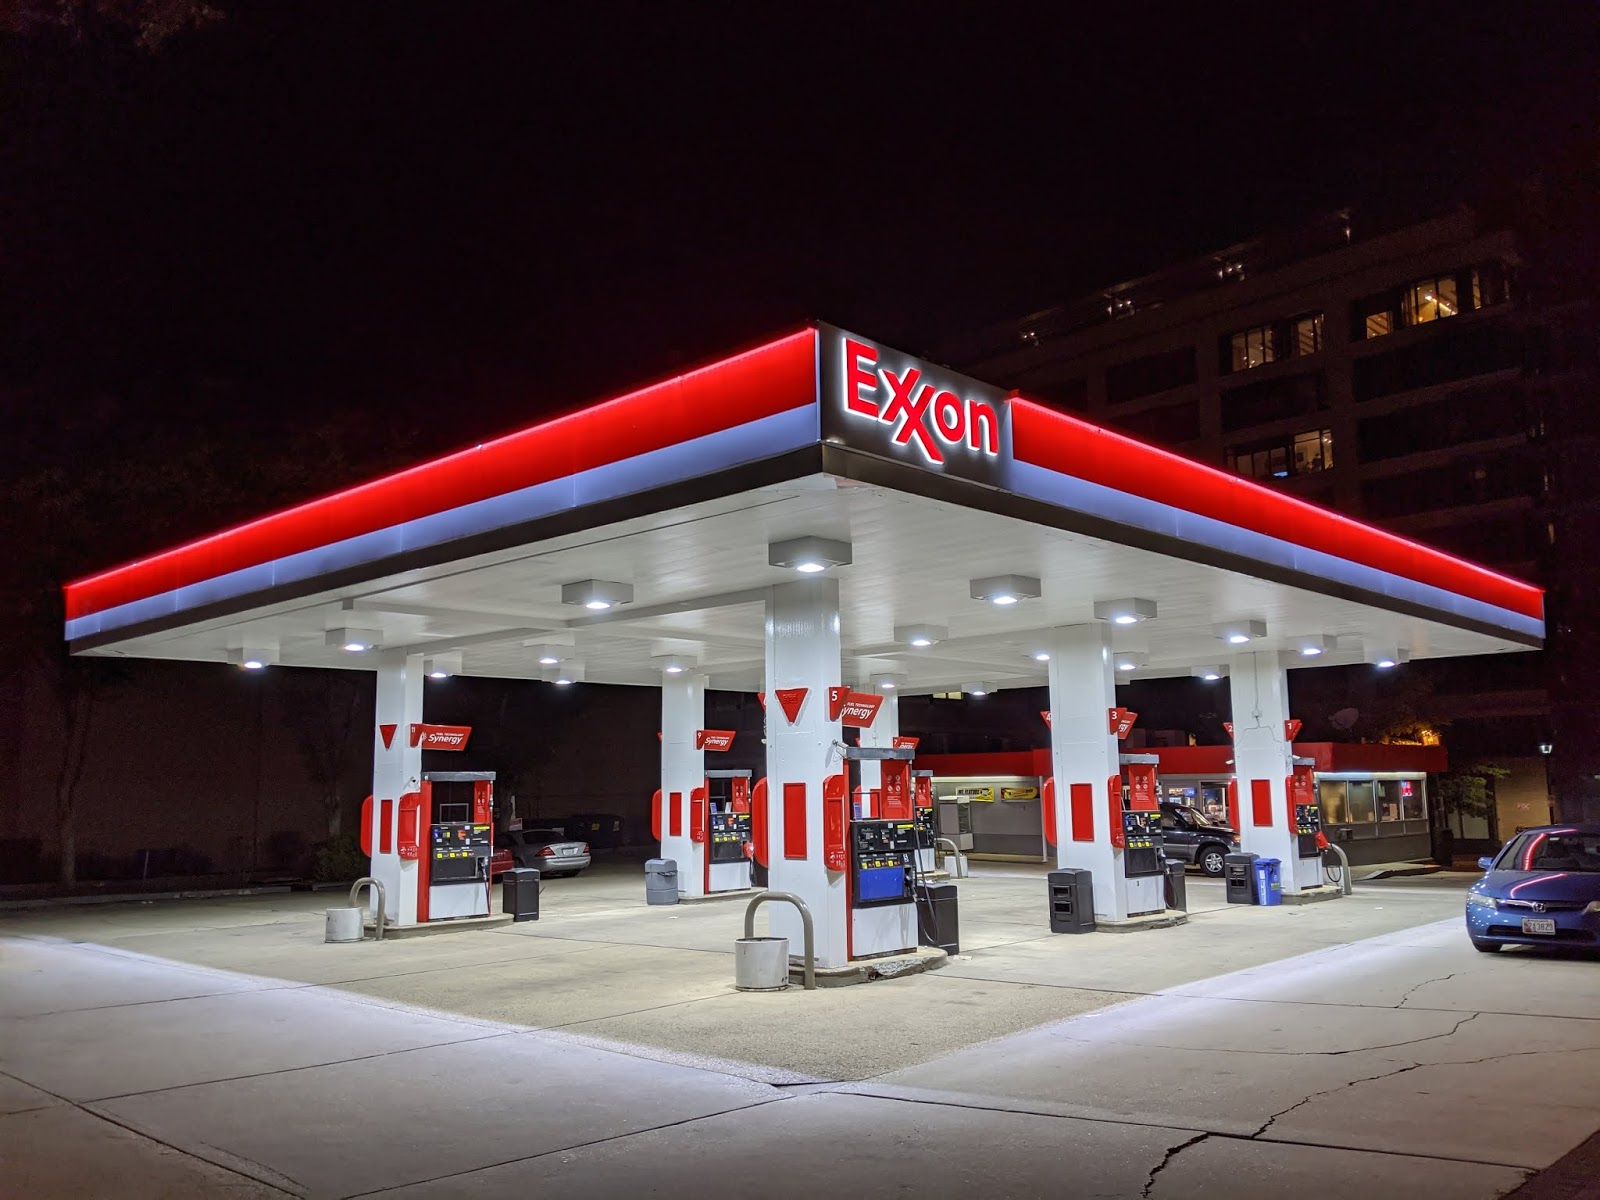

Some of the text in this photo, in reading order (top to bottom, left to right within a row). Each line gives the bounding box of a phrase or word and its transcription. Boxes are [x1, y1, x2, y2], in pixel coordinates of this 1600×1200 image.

[843, 338, 998, 465] Exxon
[831, 690, 838, 701] 5
[841, 706, 873, 719] ynergy
[1112, 711, 1118, 719] 3
[428, 733, 463, 745] Synergy
[704, 736, 728, 746] Synergy
